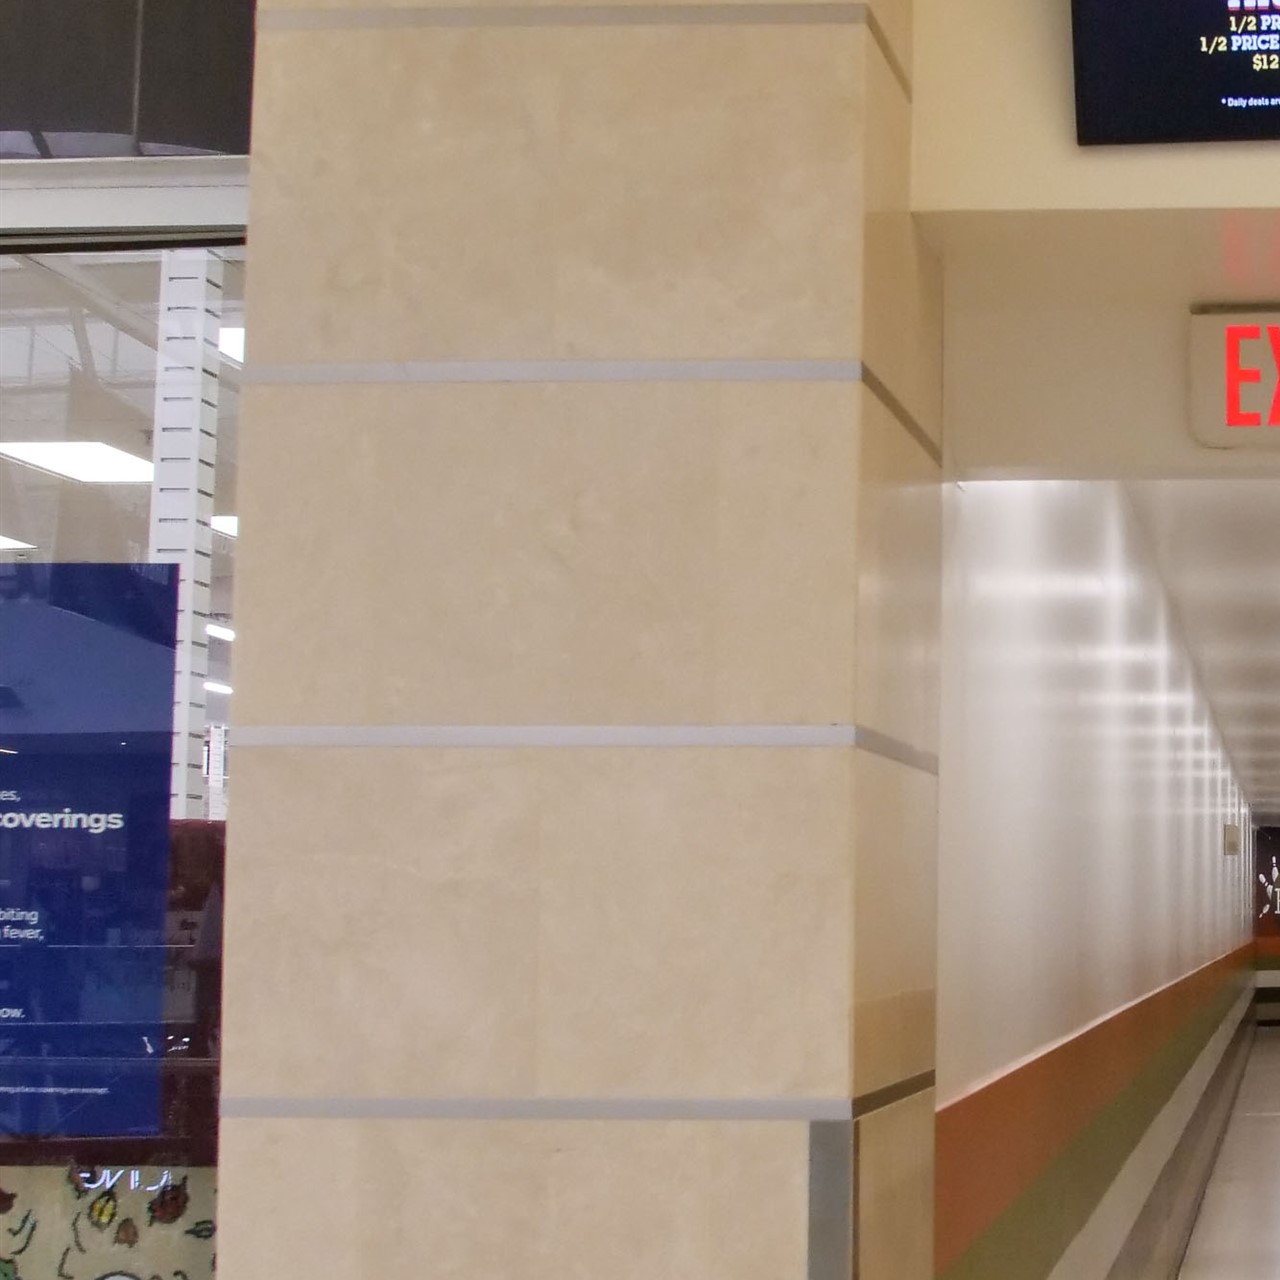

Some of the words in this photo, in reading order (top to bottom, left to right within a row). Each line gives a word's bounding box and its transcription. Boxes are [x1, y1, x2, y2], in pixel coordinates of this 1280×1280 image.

[1229, 16, 1257, 33] 1/2
[1200, 36, 1227, 54] 1/2
[1231, 34, 1280, 51] PRICE
[1253, 53, 1279, 71] $12
[1227, 98, 1247, 108] Daily
[1248, 97, 1269, 106] deals
[4, 925, 44, 941] fever,
